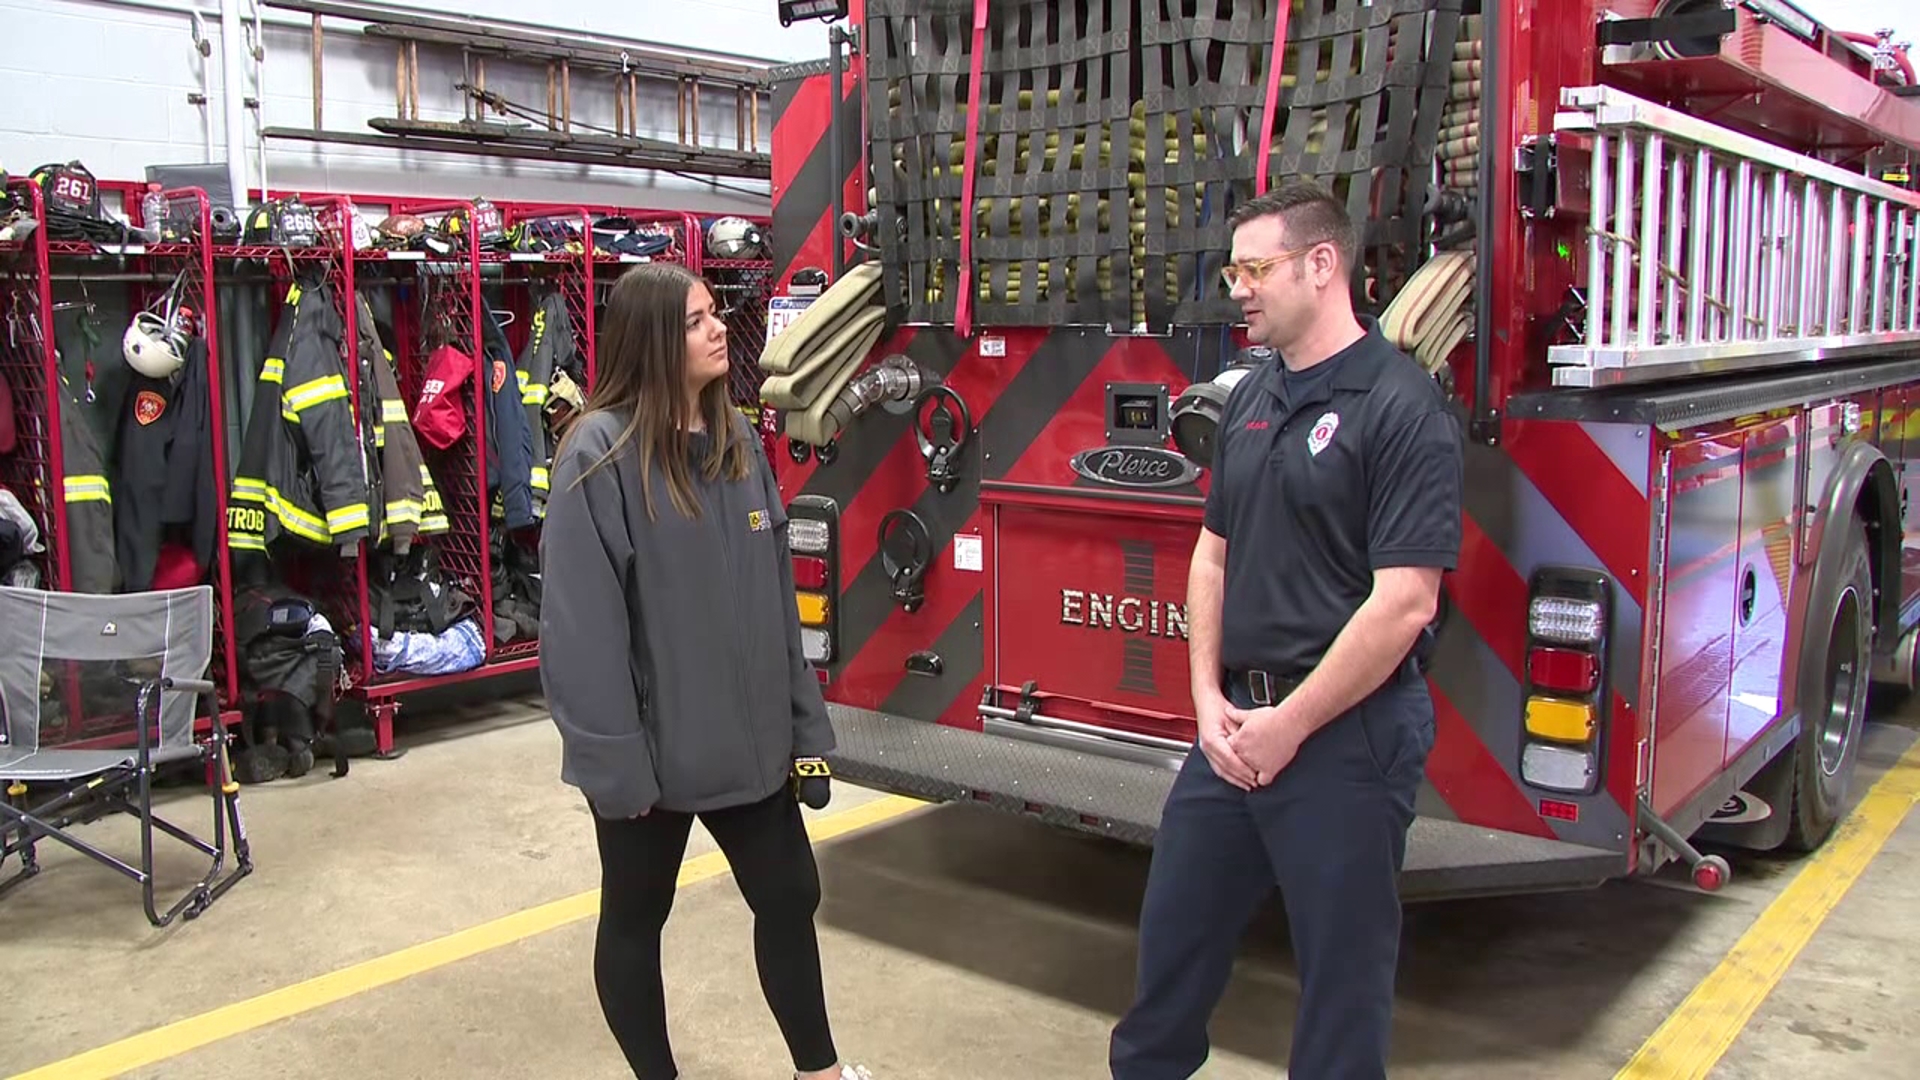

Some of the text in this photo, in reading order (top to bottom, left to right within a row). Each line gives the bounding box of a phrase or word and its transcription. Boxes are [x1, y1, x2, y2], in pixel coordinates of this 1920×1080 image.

[56, 177, 91, 201] 261
[284, 213, 313, 231] 266
[1097, 450, 1171, 478] Pierce
[1060, 588, 1189, 639] ENGIN
